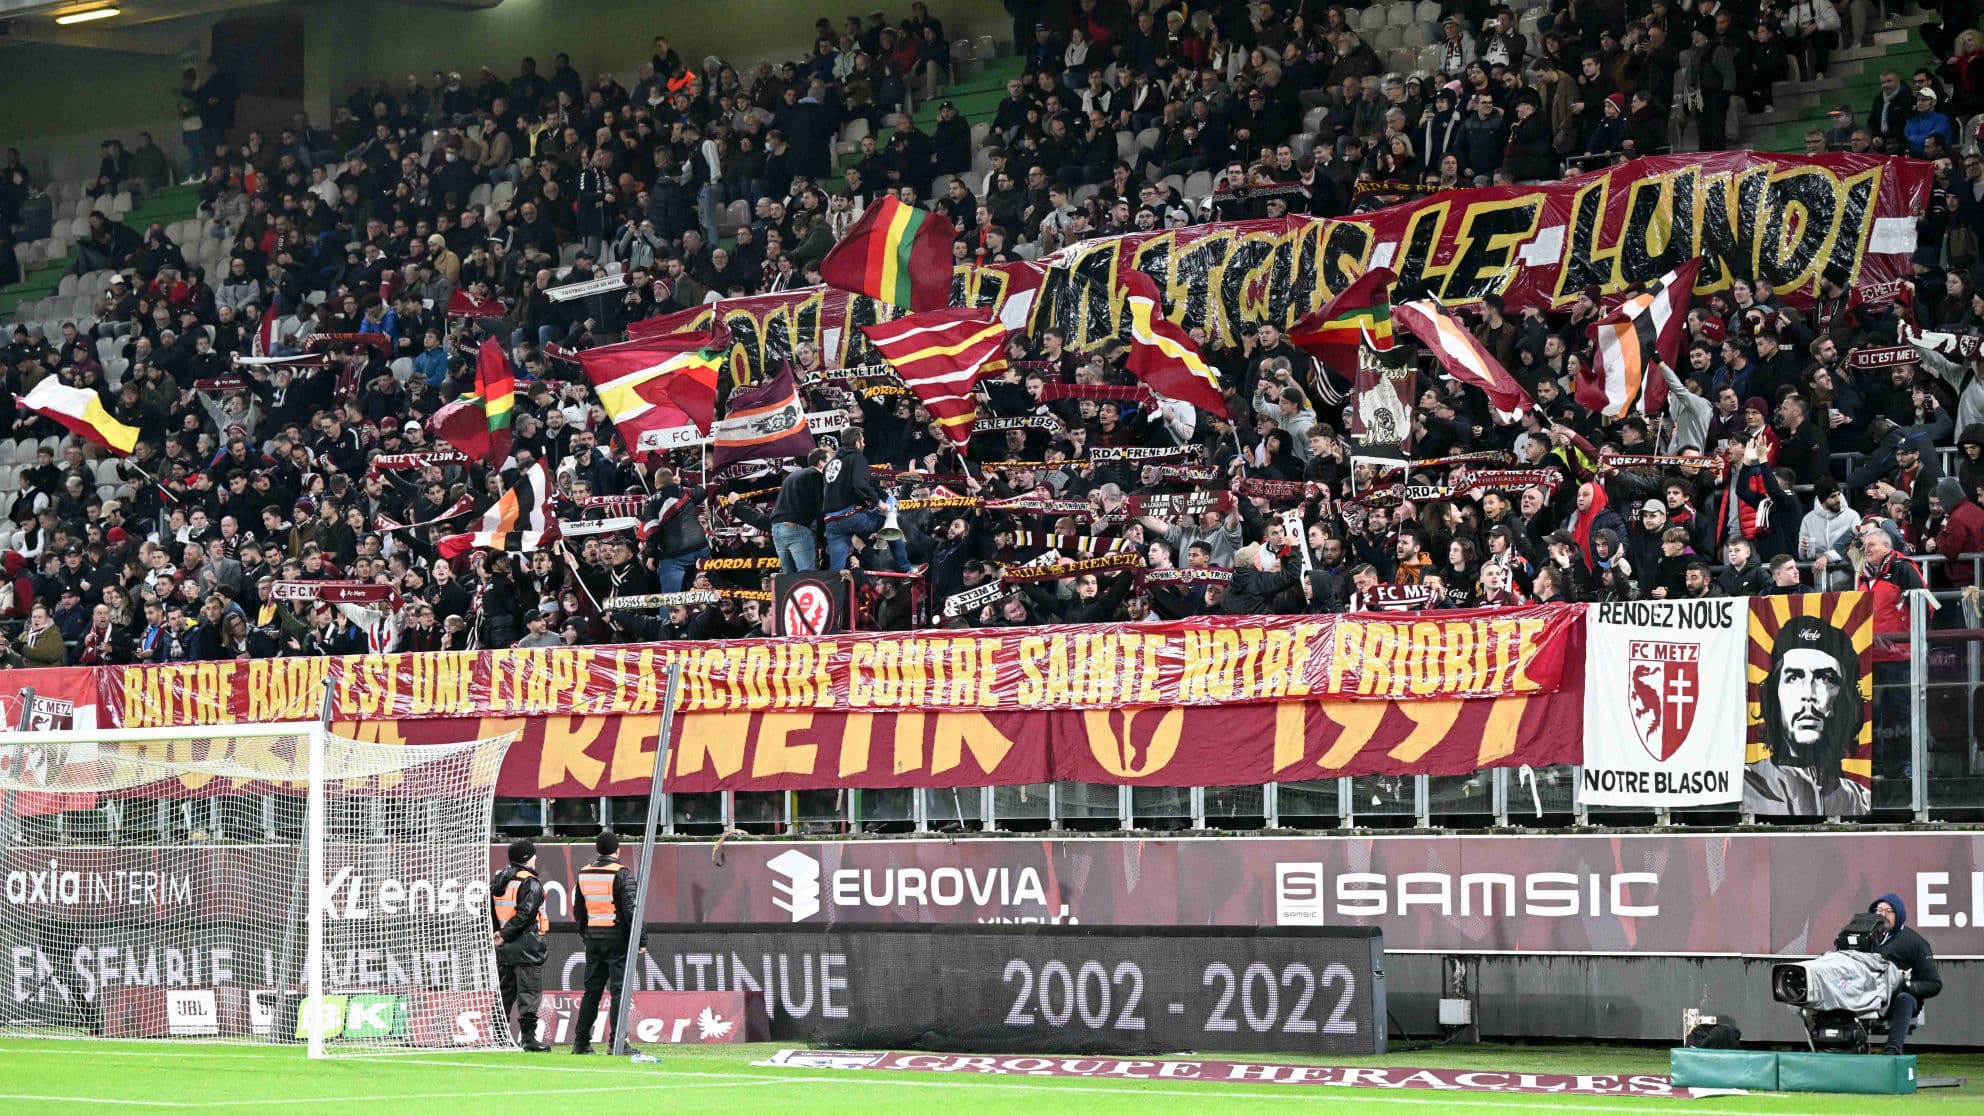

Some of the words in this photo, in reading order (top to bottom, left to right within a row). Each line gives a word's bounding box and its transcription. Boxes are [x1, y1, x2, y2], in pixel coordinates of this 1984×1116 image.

[1389, 193, 1546, 303] LE
[1553, 161, 1884, 308] LUNDI
[1861, 288, 1874, 302] FC
[1875, 282, 1900, 298] METZ
[1858, 355, 1869, 365] ICI
[1870, 352, 1894, 363] C'EST
[974, 417, 1025, 430] RENETIK
[1090, 448, 1121, 460] RDA
[1406, 486, 1440, 499] ORDA
[899, 500, 920, 511] RDA
[704, 557, 752, 571] HORDA
[1069, 552, 1140, 572] FRENETI
[1378, 585, 1397, 600] FC
[1599, 601, 1673, 629] RENDEZ
[1678, 601, 1733, 629] NOUS
[1632, 643, 1650, 660] FC
[1654, 643, 1698, 661] METZ
[124, 661, 236, 728] BATTRE
[340, 652, 401, 716] EST
[410, 652, 478, 714] UNE
[612, 648, 656, 712] LA
[849, 637, 1002, 708] CONTRE
[1018, 631, 1166, 706] SAINTE
[1178, 623, 1320, 702] NOTRE
[32, 698, 43, 711] FC
[46, 702, 71, 716] METZ
[1584, 769, 1650, 794] NOTRE
[1654, 770, 1729, 794] BLASON
[6, 859, 81, 905] axia
[88, 870, 192, 905] INTERIM
[832, 867, 1046, 906] EUROVIA
[1336, 871, 1659, 917] SAMSIC
[562, 950, 848, 1020] CNTINUE
[1003, 958, 1146, 1031] 2002
[1203, 961, 1357, 1035] 2022
[176, 1000, 208, 1016] JBL
[893, 1052, 1202, 1079] GROUPE
[1226, 1062, 1674, 1094] HERACLES
